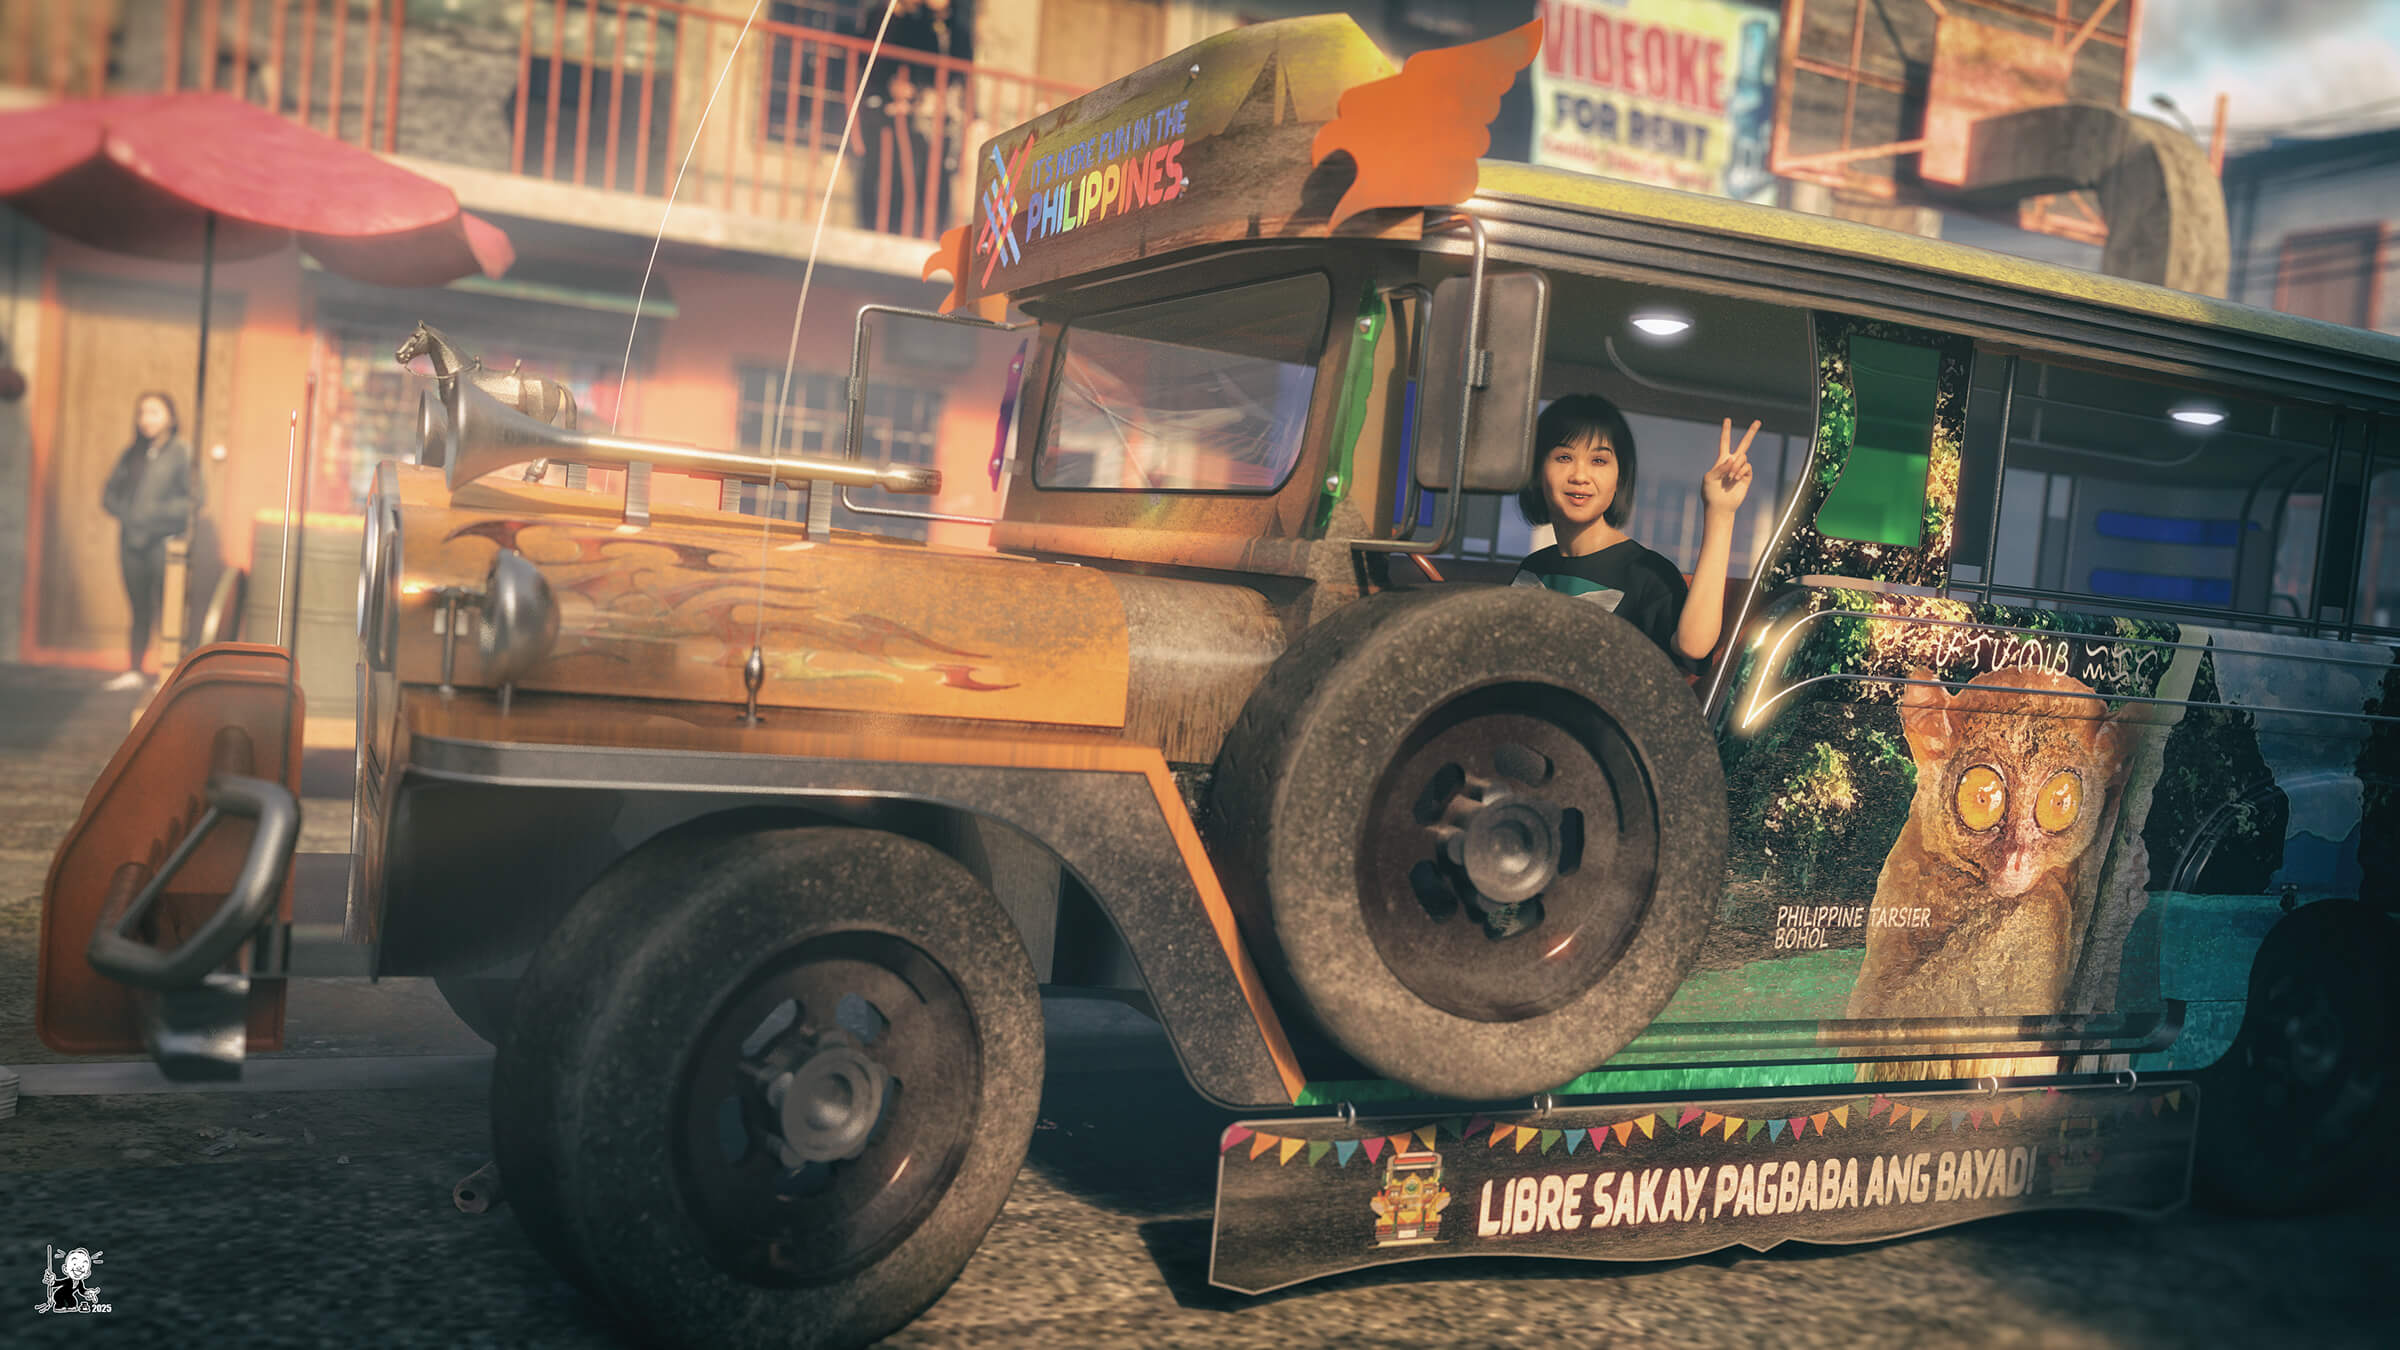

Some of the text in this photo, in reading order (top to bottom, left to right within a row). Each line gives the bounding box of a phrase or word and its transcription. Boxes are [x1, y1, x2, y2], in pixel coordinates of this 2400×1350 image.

[1541, 0, 1726, 115] VIDEOKE
[1030, 100, 1189, 190] IT'S MORE FUN IN THE
[1555, 92, 1619, 143] FOR
[1628, 107, 1710, 163] RENT
[1025, 138, 1185, 243] PHILIPPINES
[1774, 926, 1829, 949] BOHOL
[1776, 905, 1931, 928] PHILIPPINE TARSIER
[1478, 1145, 2039, 1237] LIBRE SAKAY, PAGBABA ANG BAYAD!
